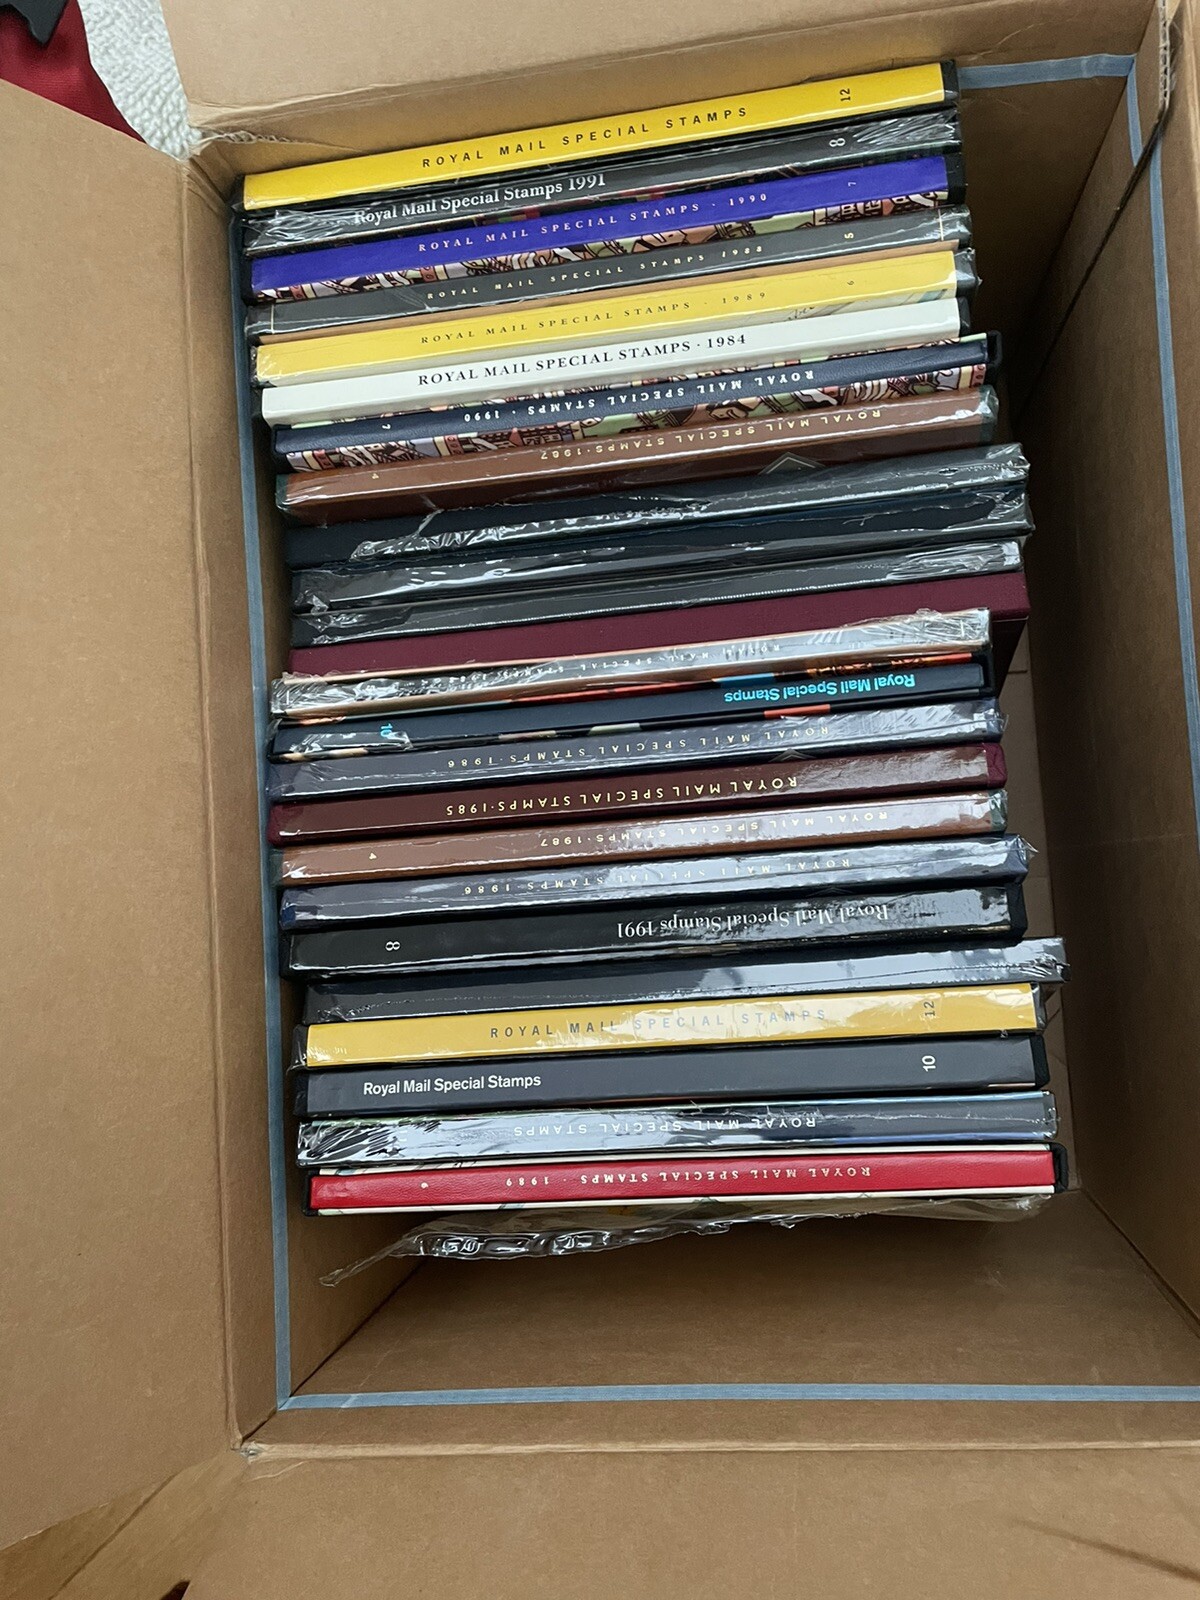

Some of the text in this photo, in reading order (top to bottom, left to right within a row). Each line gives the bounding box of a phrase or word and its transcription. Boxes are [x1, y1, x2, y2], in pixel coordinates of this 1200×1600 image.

[839, 88, 851, 102] 12
[423, 107, 747, 168] ROYAL MAIL SPECIAL STAMPS
[829, 137, 846, 148] 8
[354, 172, 606, 225] Royal Mail Special Stamps 1991
[419, 193, 768, 252] ROYAL MAIL SPECIAL STAMPS 1990
[427, 246, 763, 300] ROYAL MAIL SPECIAL STAMPS 1988
[421, 292, 766, 344] ROYAL MAIL SPECIAL STAMPS 1989
[418, 333, 746, 386] ROYAL MAIL SPECIAL STAMPS 1984
[464, 370, 814, 422] ROYAL MAIL SPECIAL STAMPS 1990
[540, 409, 881, 460] ROYAL MAIL SPECIAL STAMPS 1987
[724, 673, 915, 702] Royal Mail Special Stamps
[448, 726, 828, 768] ROYAL MAIL SPECIAL STAMPS 1986
[446, 777, 797, 816] ROYAL MAIL SPECIAL STAMPS 1985
[540, 811, 888, 846] ROYAL MAIL SPECIAL STAMPS 1987
[786, 858, 850, 871] ROYAL
[463, 883, 511, 894] 1986
[527, 875, 604, 890] STAMPS
[617, 903, 889, 938] Royal Mail Special Stamps 1991
[385, 940, 400, 951] 8
[490, 1009, 826, 1038] ROYAL MAIL SPECIAL STAMPS
[924, 1001, 935, 1018] 12
[922, 1055, 936, 1072] 10
[363, 1074, 541, 1096] Royal Mail Special Stamps
[513, 1117, 816, 1137] ROYAL MAIL SPECIAL STAMPS
[506, 1166, 870, 1187] ROYAL MAIL SPECIAL STAMPS 1989
